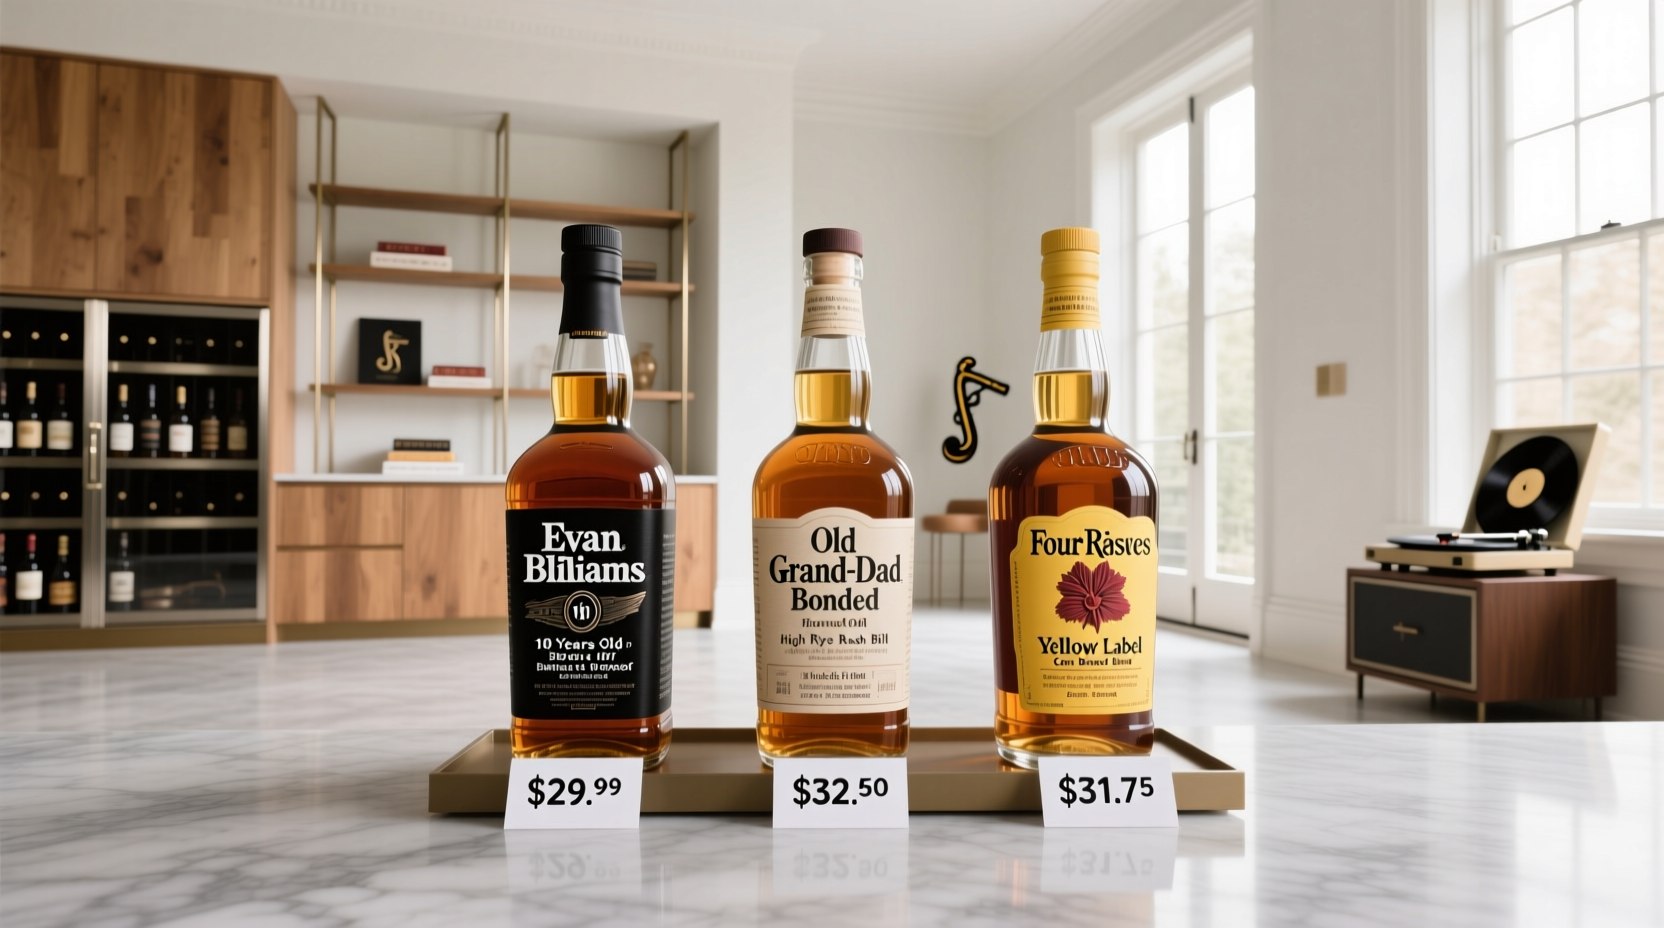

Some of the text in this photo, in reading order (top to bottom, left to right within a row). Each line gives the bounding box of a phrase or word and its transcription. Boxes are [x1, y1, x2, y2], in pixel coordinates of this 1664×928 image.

[811, 526, 856, 553] Old
[1030, 529, 1083, 556] Four
[769, 554, 901, 583] Grand-Dad
[791, 587, 879, 611] Bonded
[535, 637, 552, 650] 10
[556, 637, 595, 650] Years
[599, 636, 623, 650] Old
[780, 633, 806, 647] High
[810, 633, 834, 647] Rye
[871, 633, 888, 645] Bill
[1037, 636, 1142, 655] Yellow Label
[527, 774, 622, 809] $29.99
[793, 774, 889, 809] $32.50
[1058, 773, 1154, 808] $31.75
